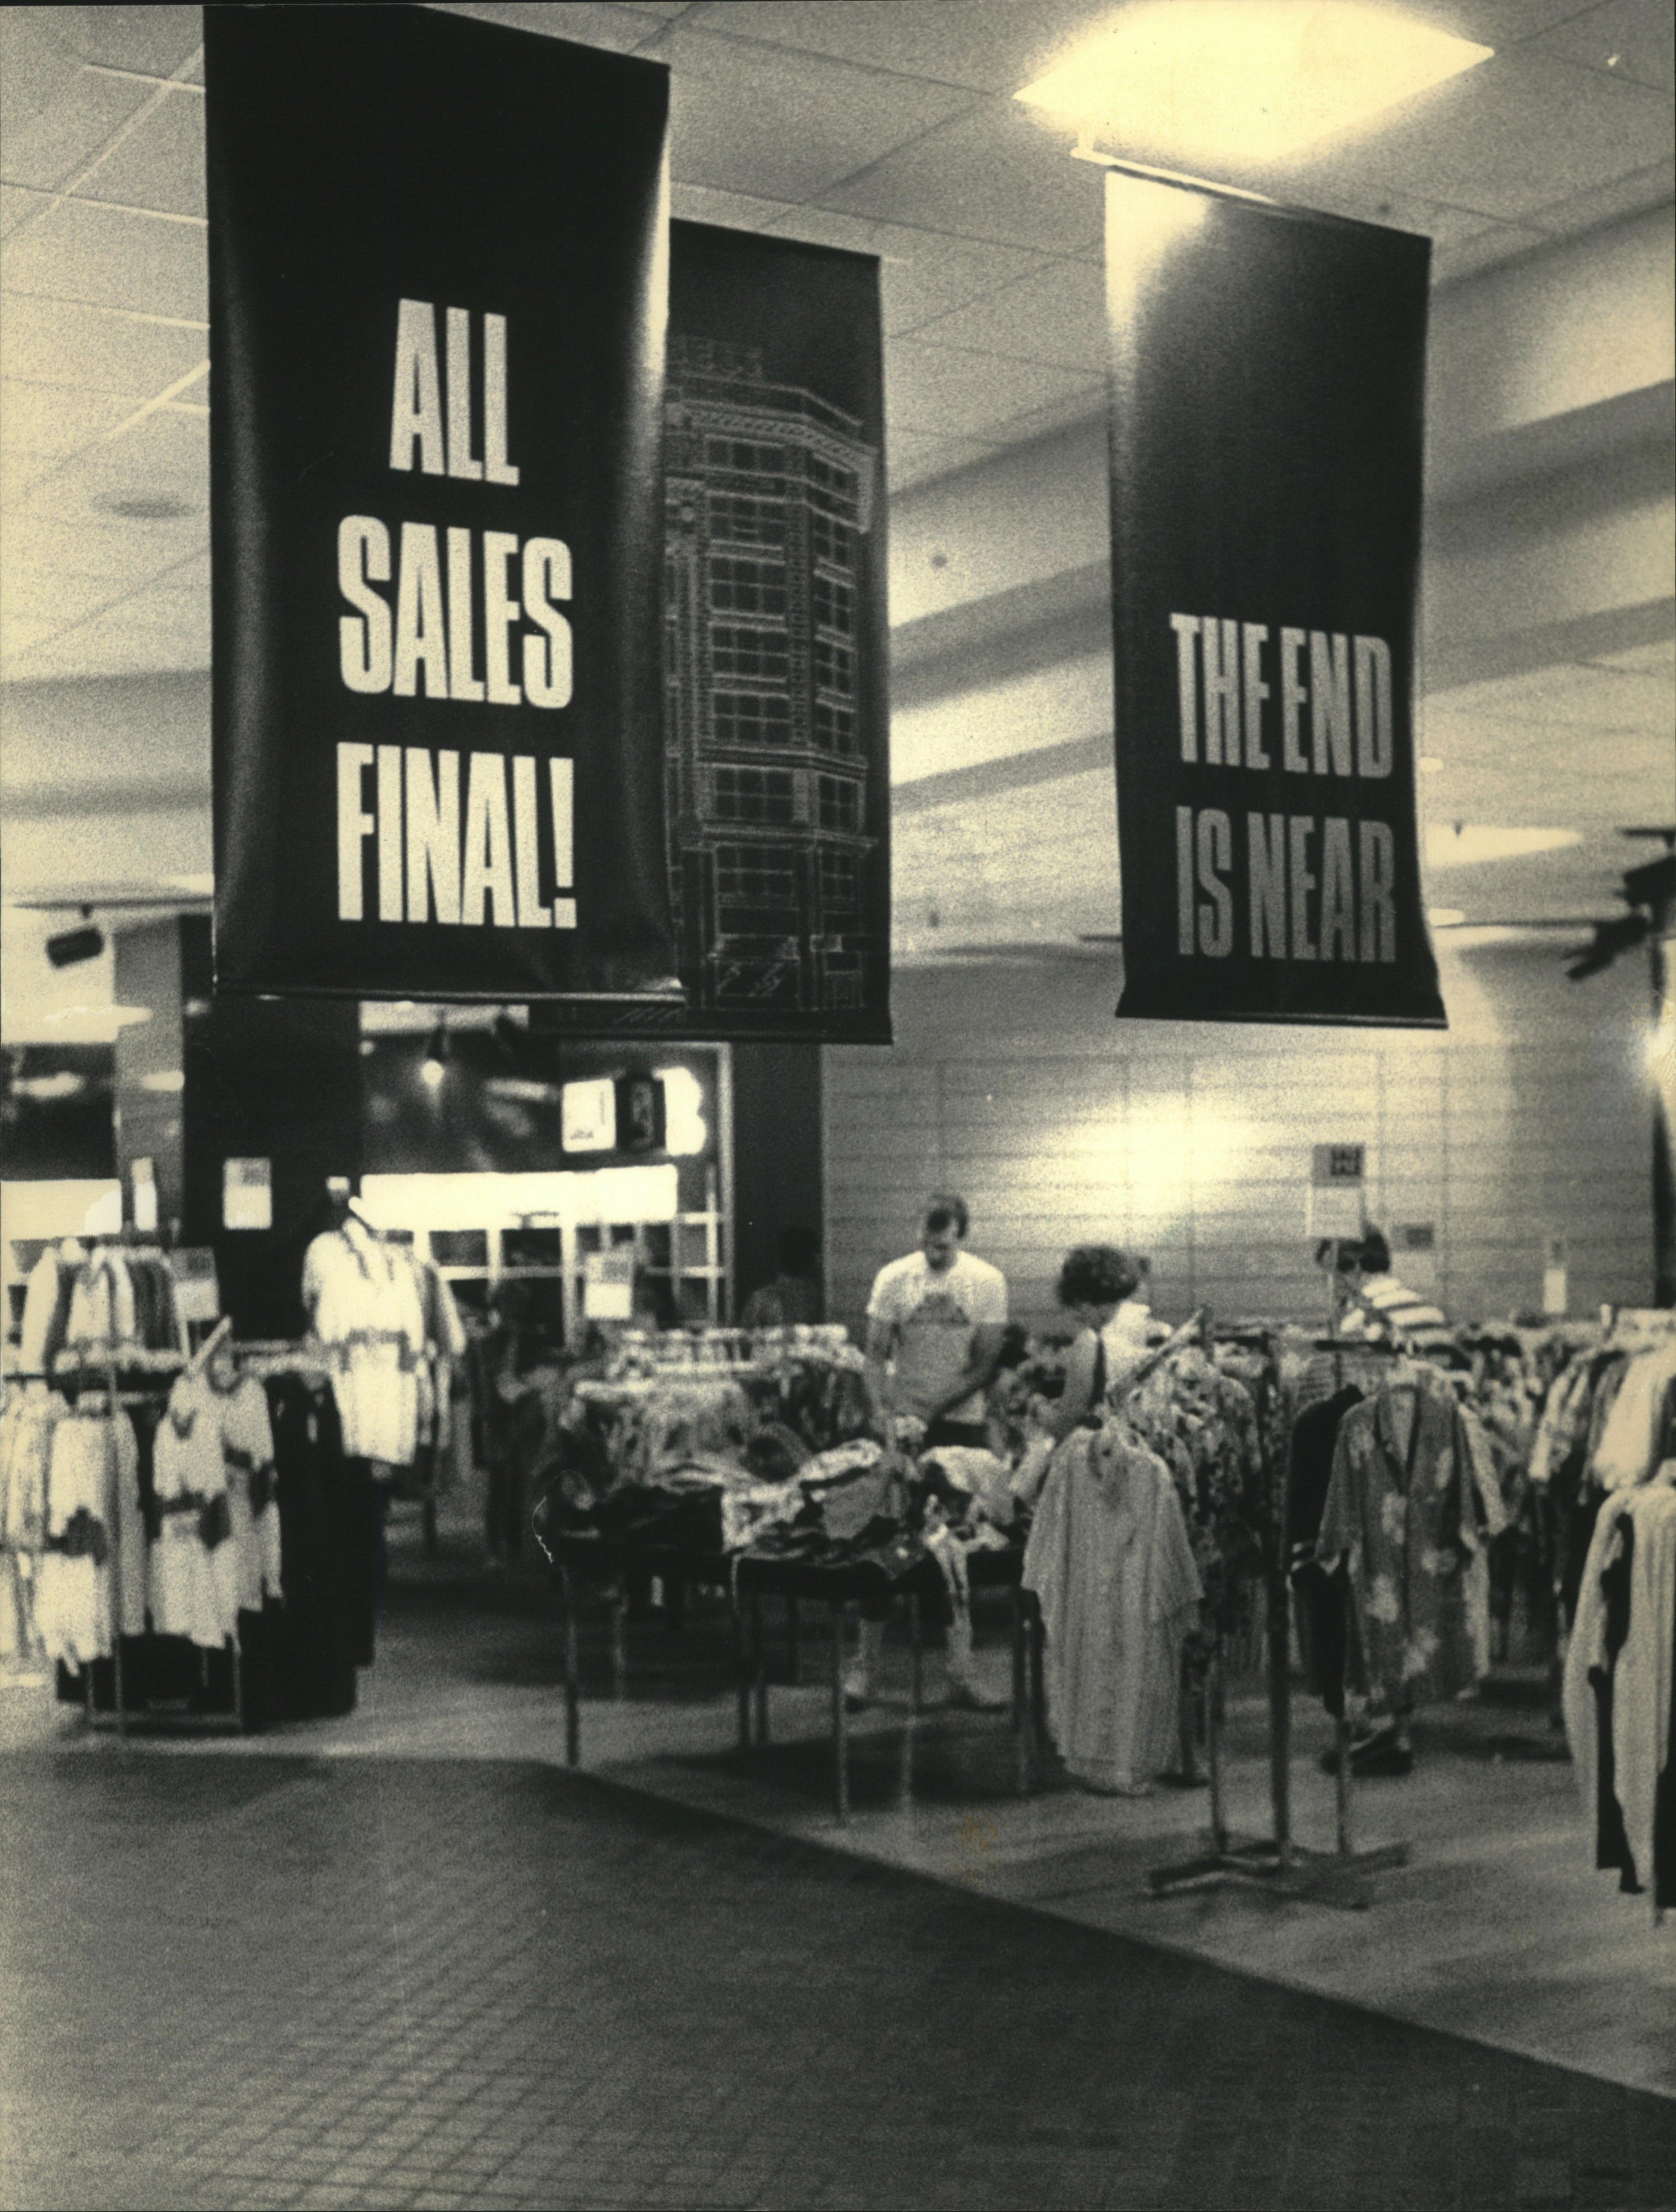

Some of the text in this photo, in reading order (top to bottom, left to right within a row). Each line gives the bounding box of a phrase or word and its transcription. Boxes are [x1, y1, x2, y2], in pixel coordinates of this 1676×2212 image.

[389, 298, 520, 487] ALL
[337, 515, 573, 709] SALES
[1169, 612, 1392, 779] THE END
[336, 741, 577, 929] FINAL!
[1175, 804, 1396, 963] IS NEAR
